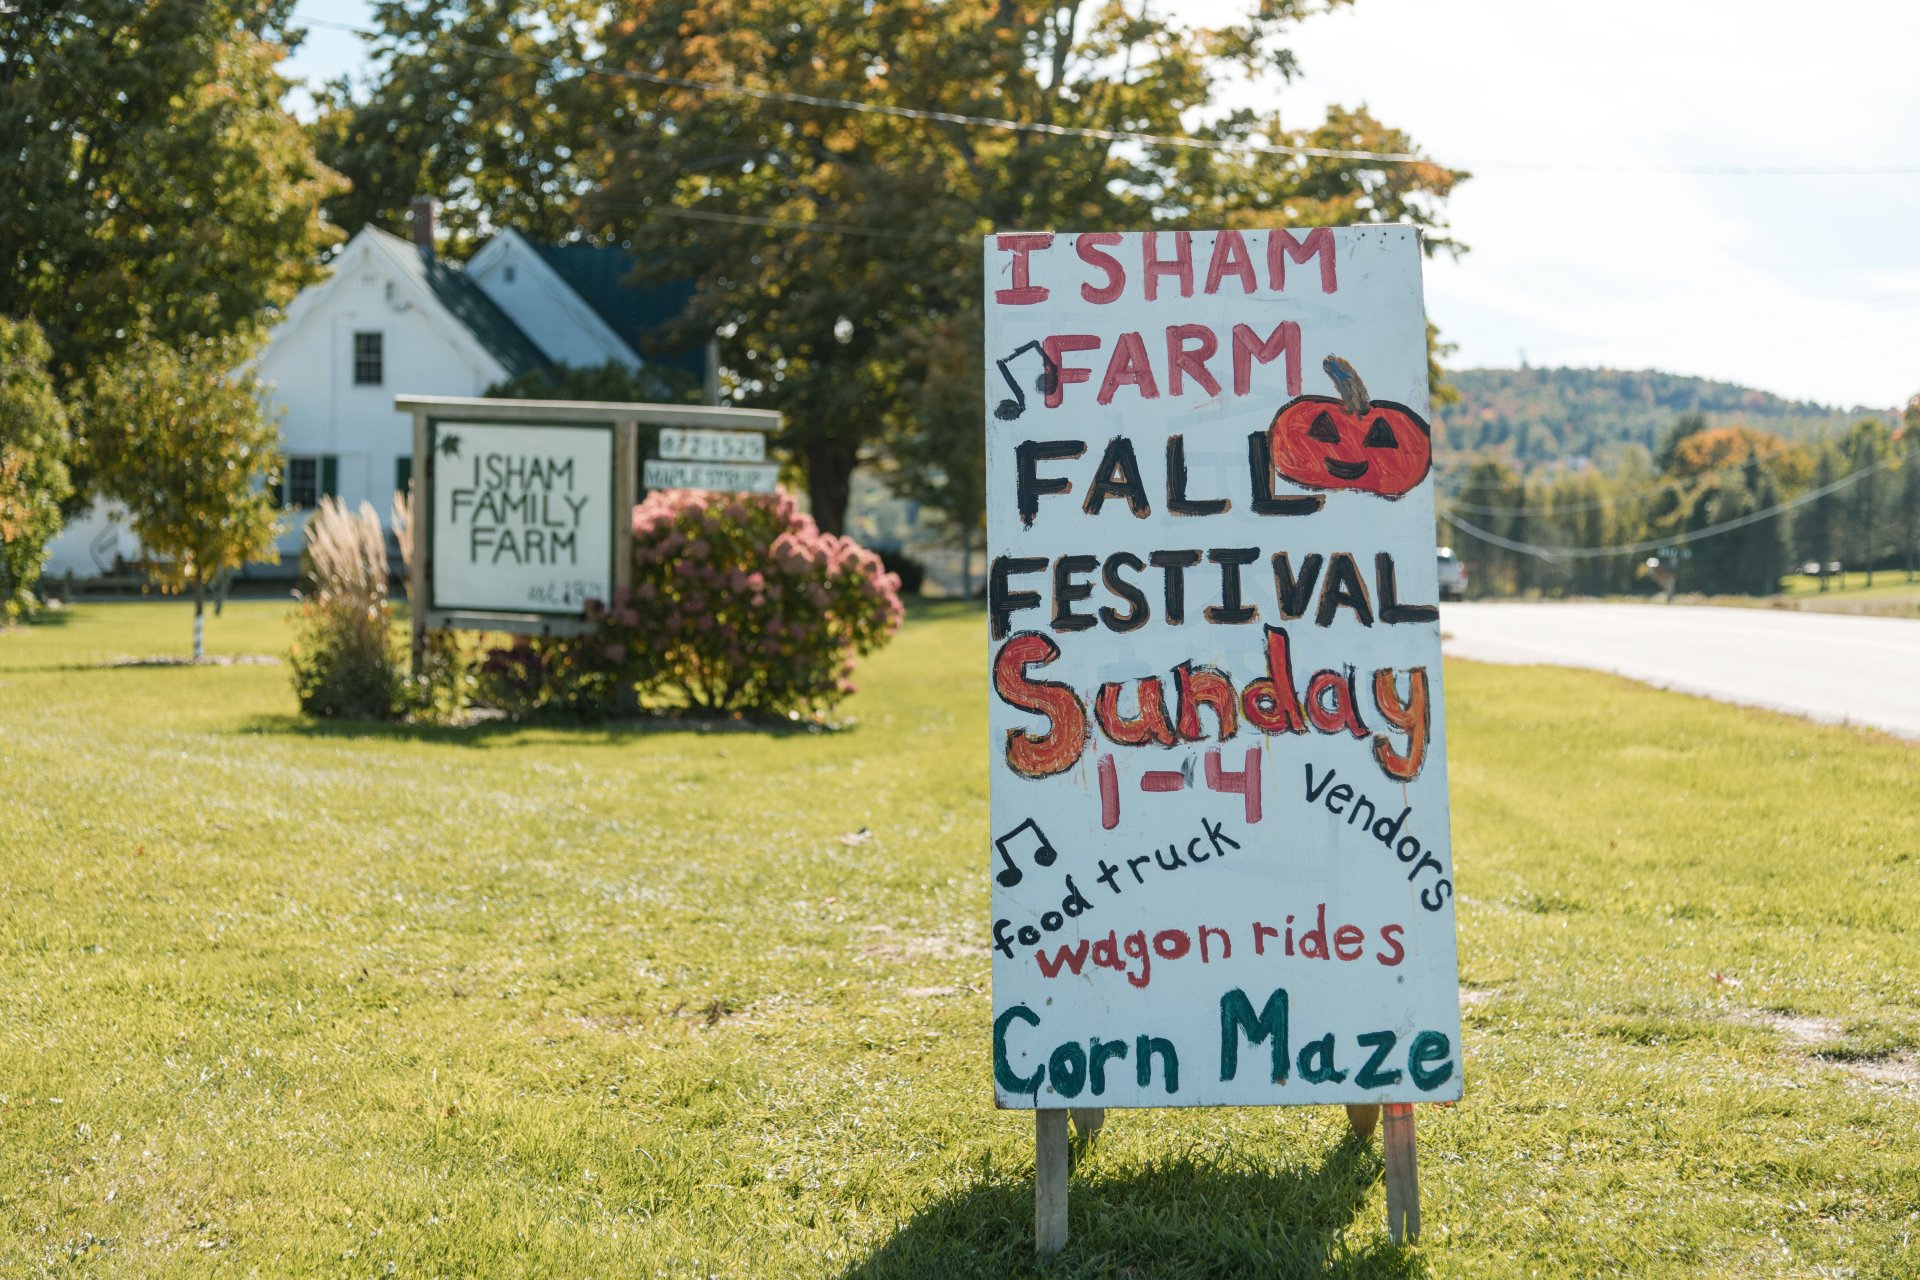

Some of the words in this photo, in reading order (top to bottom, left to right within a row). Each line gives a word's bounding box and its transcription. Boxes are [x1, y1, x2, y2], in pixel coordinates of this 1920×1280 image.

[995, 227, 1338, 305] ISHAM
[1042, 320, 1303, 409] FARM
[451, 489, 589, 527] FAMILY
[473, 453, 574, 491] ISHAM
[1014, 431, 1327, 528] FALL
[471, 527, 577, 564] FARM
[990, 546, 1439, 640] FESTIVAL
[993, 623, 1431, 783] Sunday
[993, 874, 1094, 959] food
[1097, 817, 1241, 893] truck
[1035, 923, 1231, 989] wagon
[1253, 903, 1406, 967] rides
[994, 1005, 1179, 1100] Corn
[1220, 987, 1454, 1092] Maze
